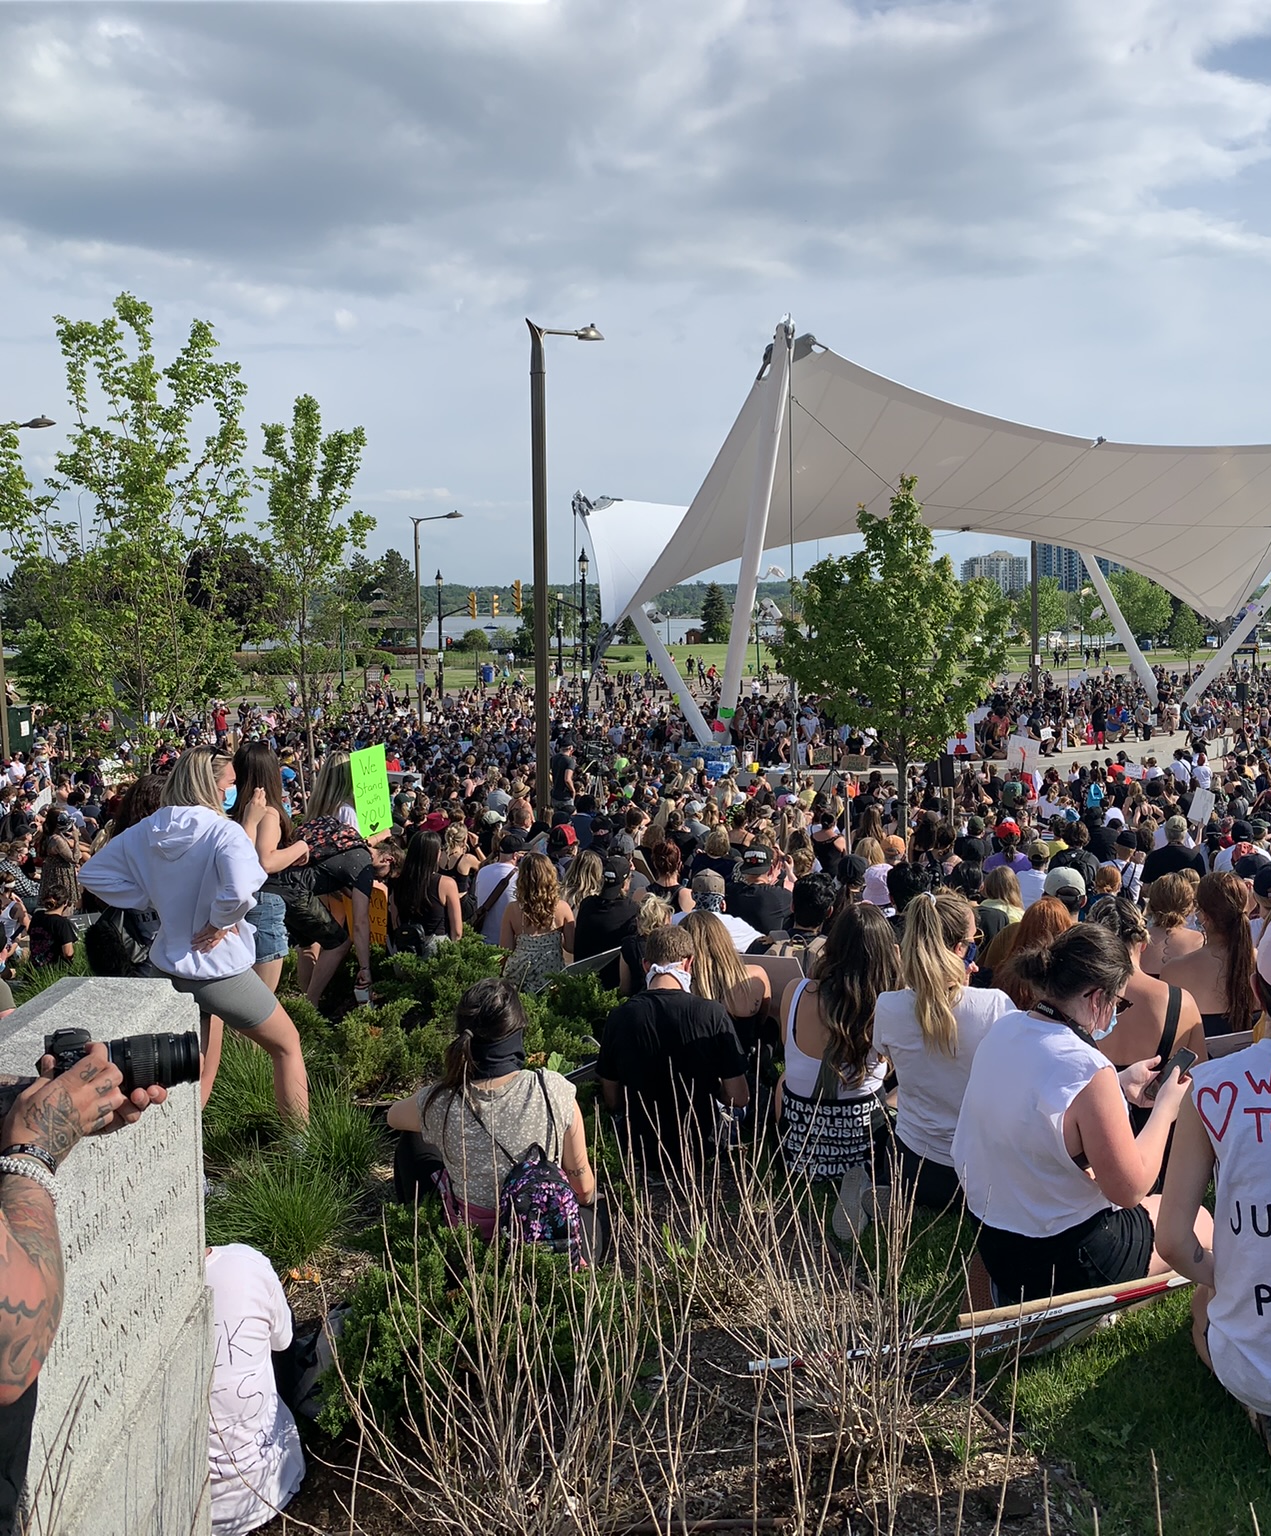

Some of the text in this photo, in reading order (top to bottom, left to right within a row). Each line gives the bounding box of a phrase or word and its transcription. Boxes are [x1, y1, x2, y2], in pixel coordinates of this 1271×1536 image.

[359, 756, 377, 775] We
[356, 778, 383, 798] Stand
[366, 794, 381, 805] with
[361, 804, 386, 824] YOU
[1037, 1002, 1054, 1015] Canon
[790, 1098, 881, 1116] TRANSPHOBIA
[784, 1107, 871, 1128] NO VIOLENCE
[789, 1121, 864, 1138] NO RACISM
[806, 1141, 876, 1156] KINDNESS
[980, 1342, 1010, 1358] TACKS
